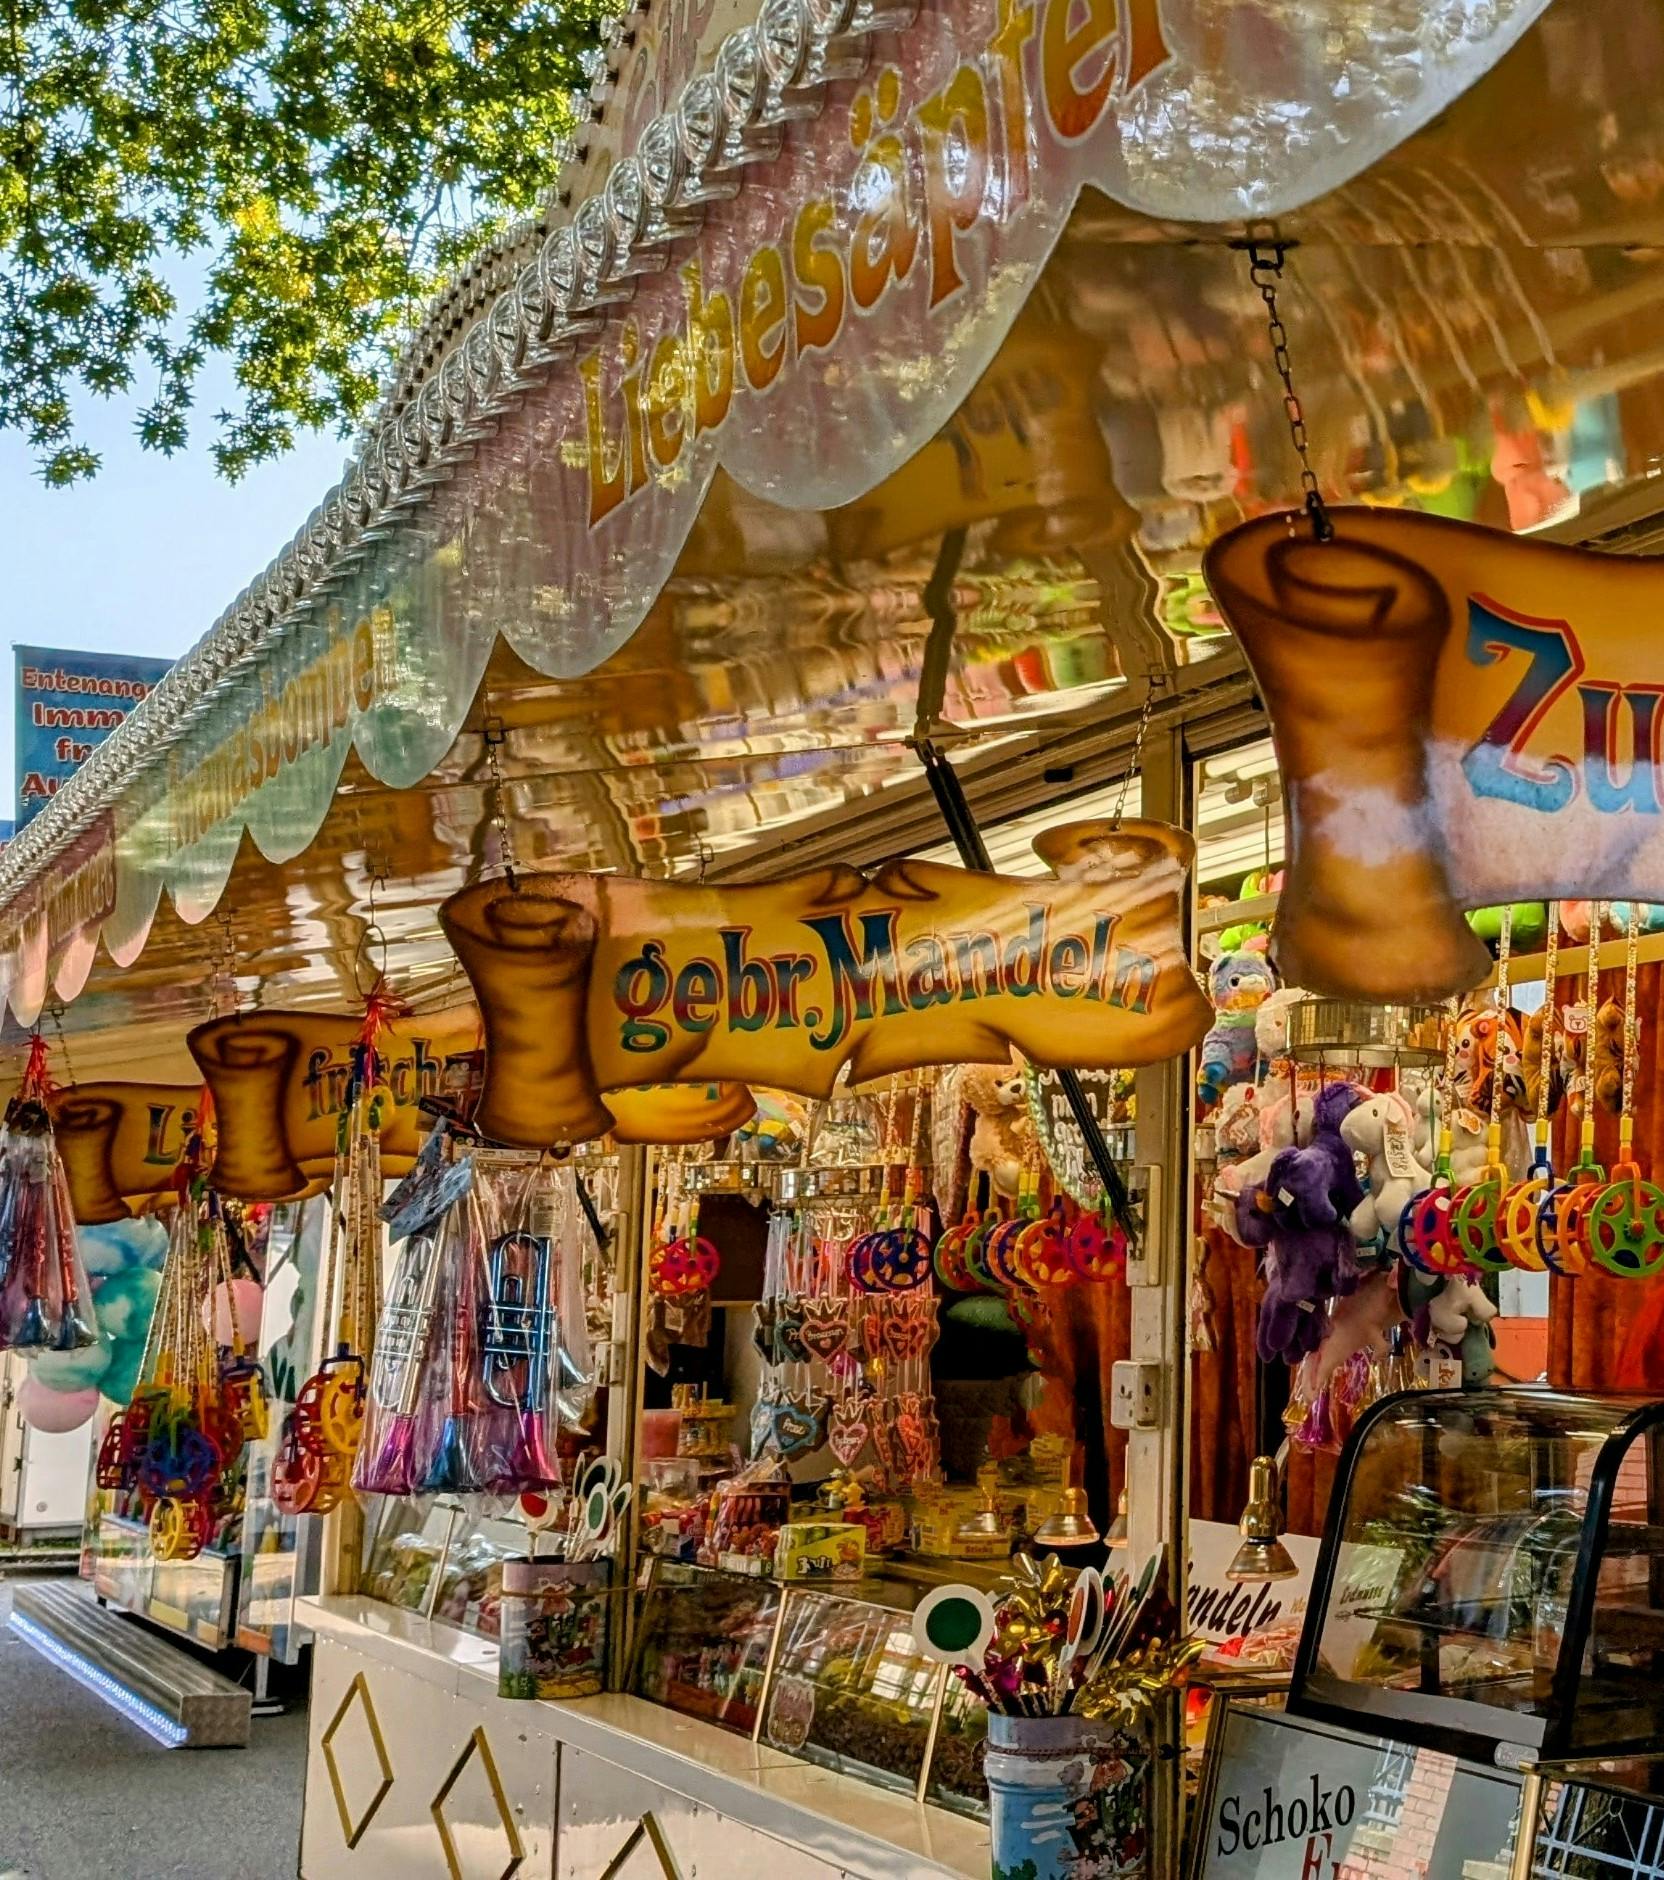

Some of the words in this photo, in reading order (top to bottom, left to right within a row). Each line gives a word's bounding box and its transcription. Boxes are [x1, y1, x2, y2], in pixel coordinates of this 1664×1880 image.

[22, 667, 150, 701] Entenang
[33, 702, 127, 727] Imm
[20, 772, 66, 797] Au
[1187, 1575, 1282, 1637] andeln
[1217, 1773, 1356, 1857] Schoko
